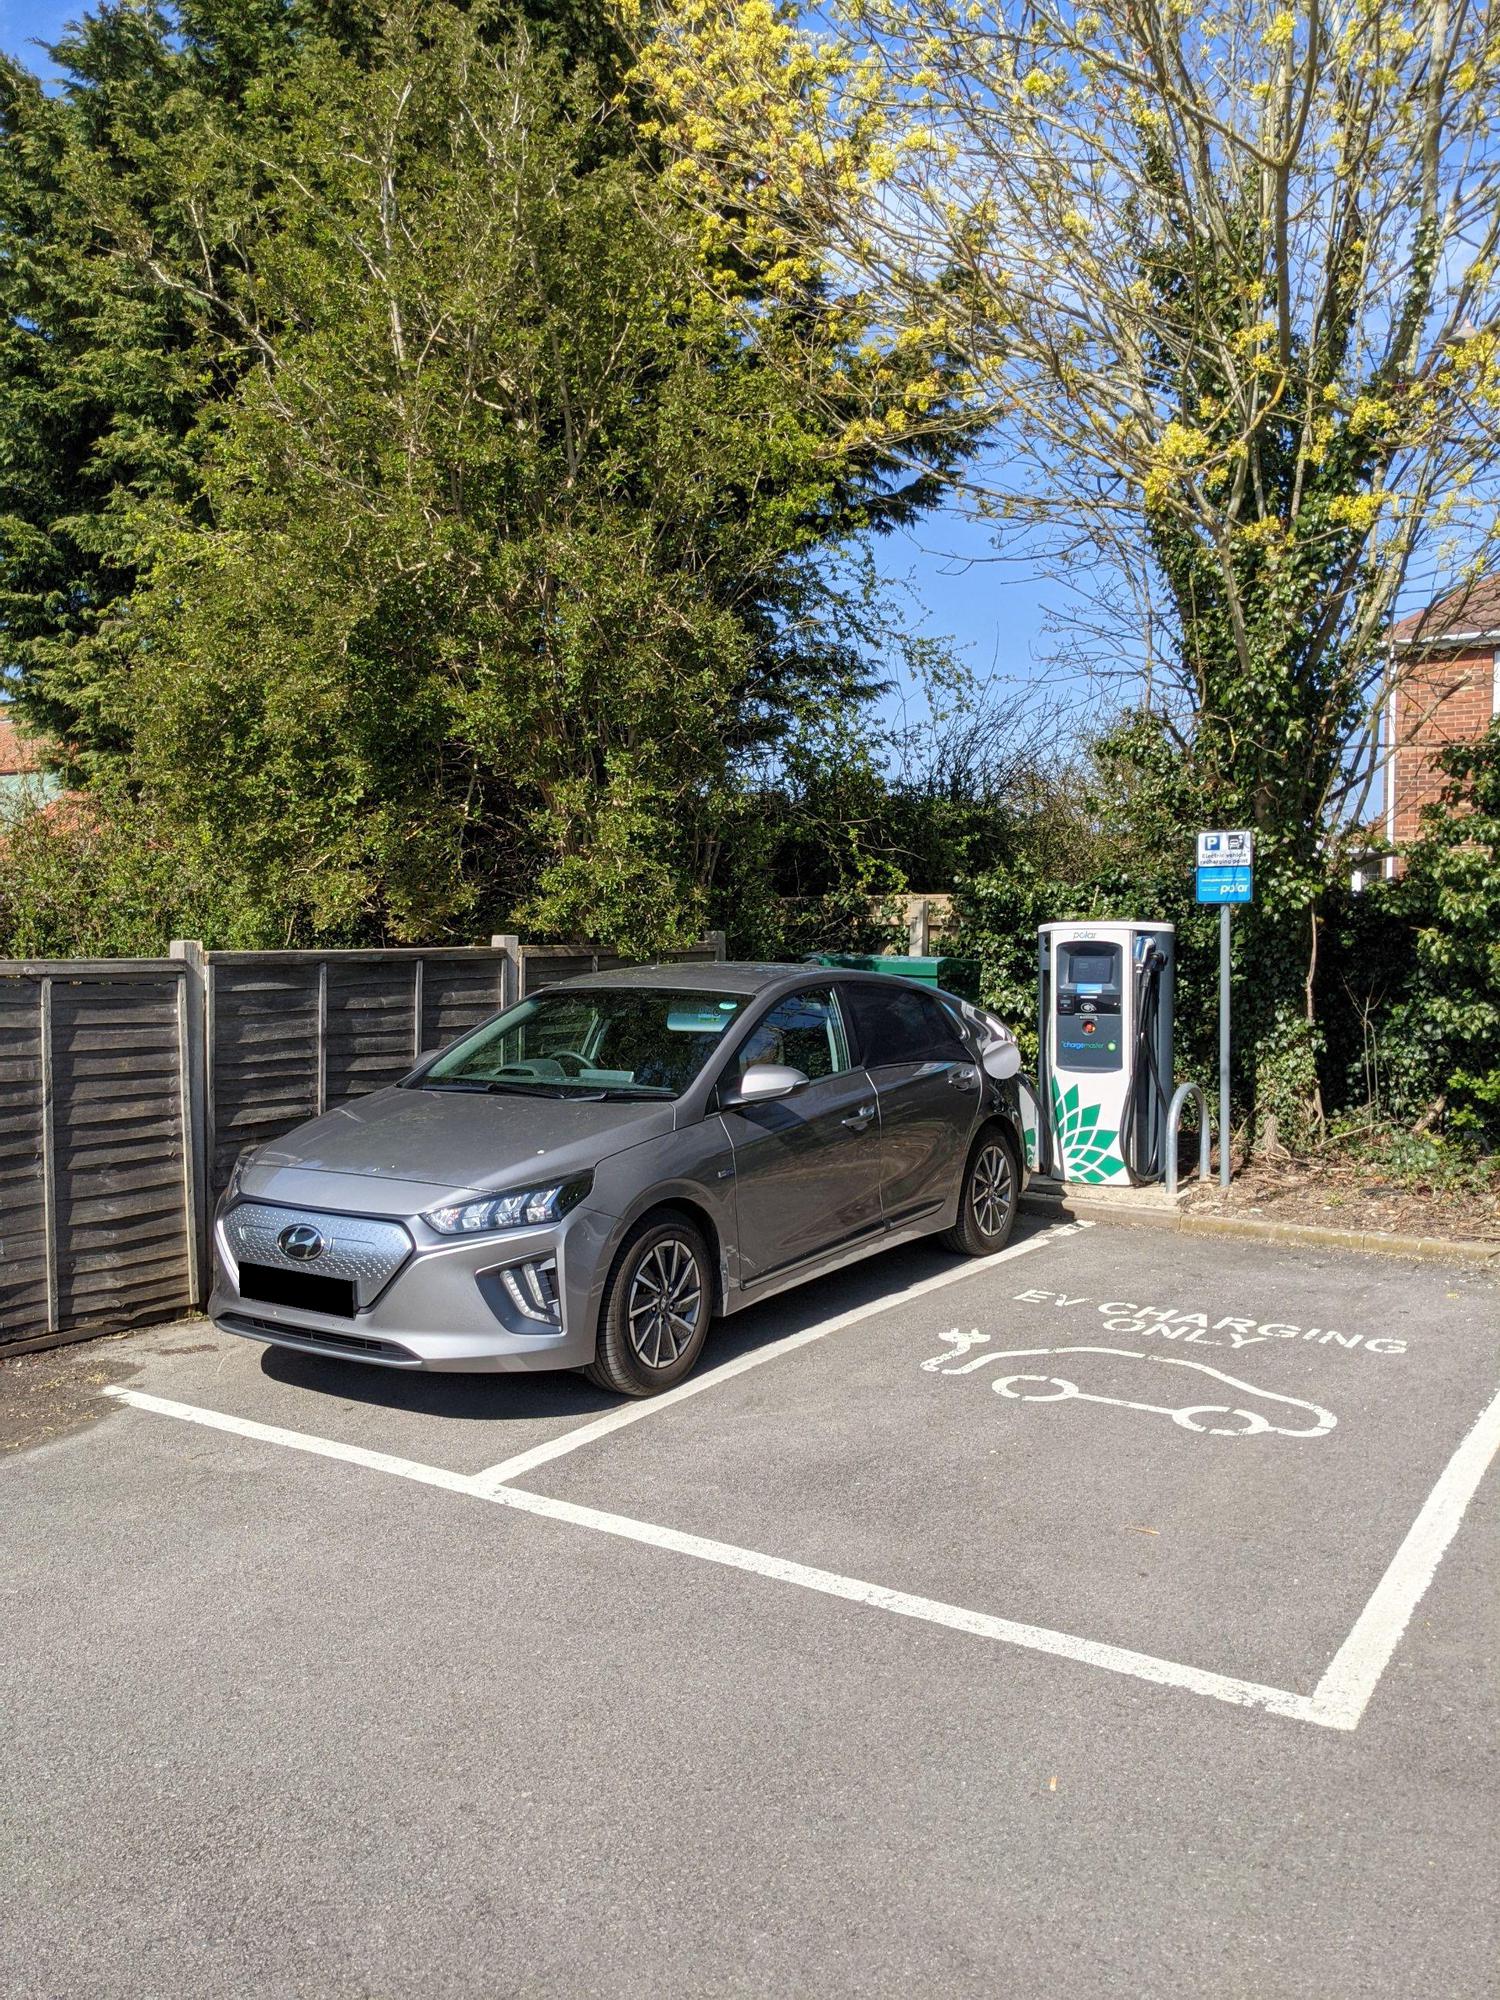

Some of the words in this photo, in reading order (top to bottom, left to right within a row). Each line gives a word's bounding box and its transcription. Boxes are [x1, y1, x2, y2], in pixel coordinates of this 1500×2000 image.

[1206, 837, 1218, 850] P
[1220, 882, 1249, 895] polar
[1073, 931, 1096, 940] polar
[1012, 1289, 1093, 1307] EV
[1098, 1302, 1408, 1354] CHARGING
[1102, 1318, 1267, 1350] ONLY
